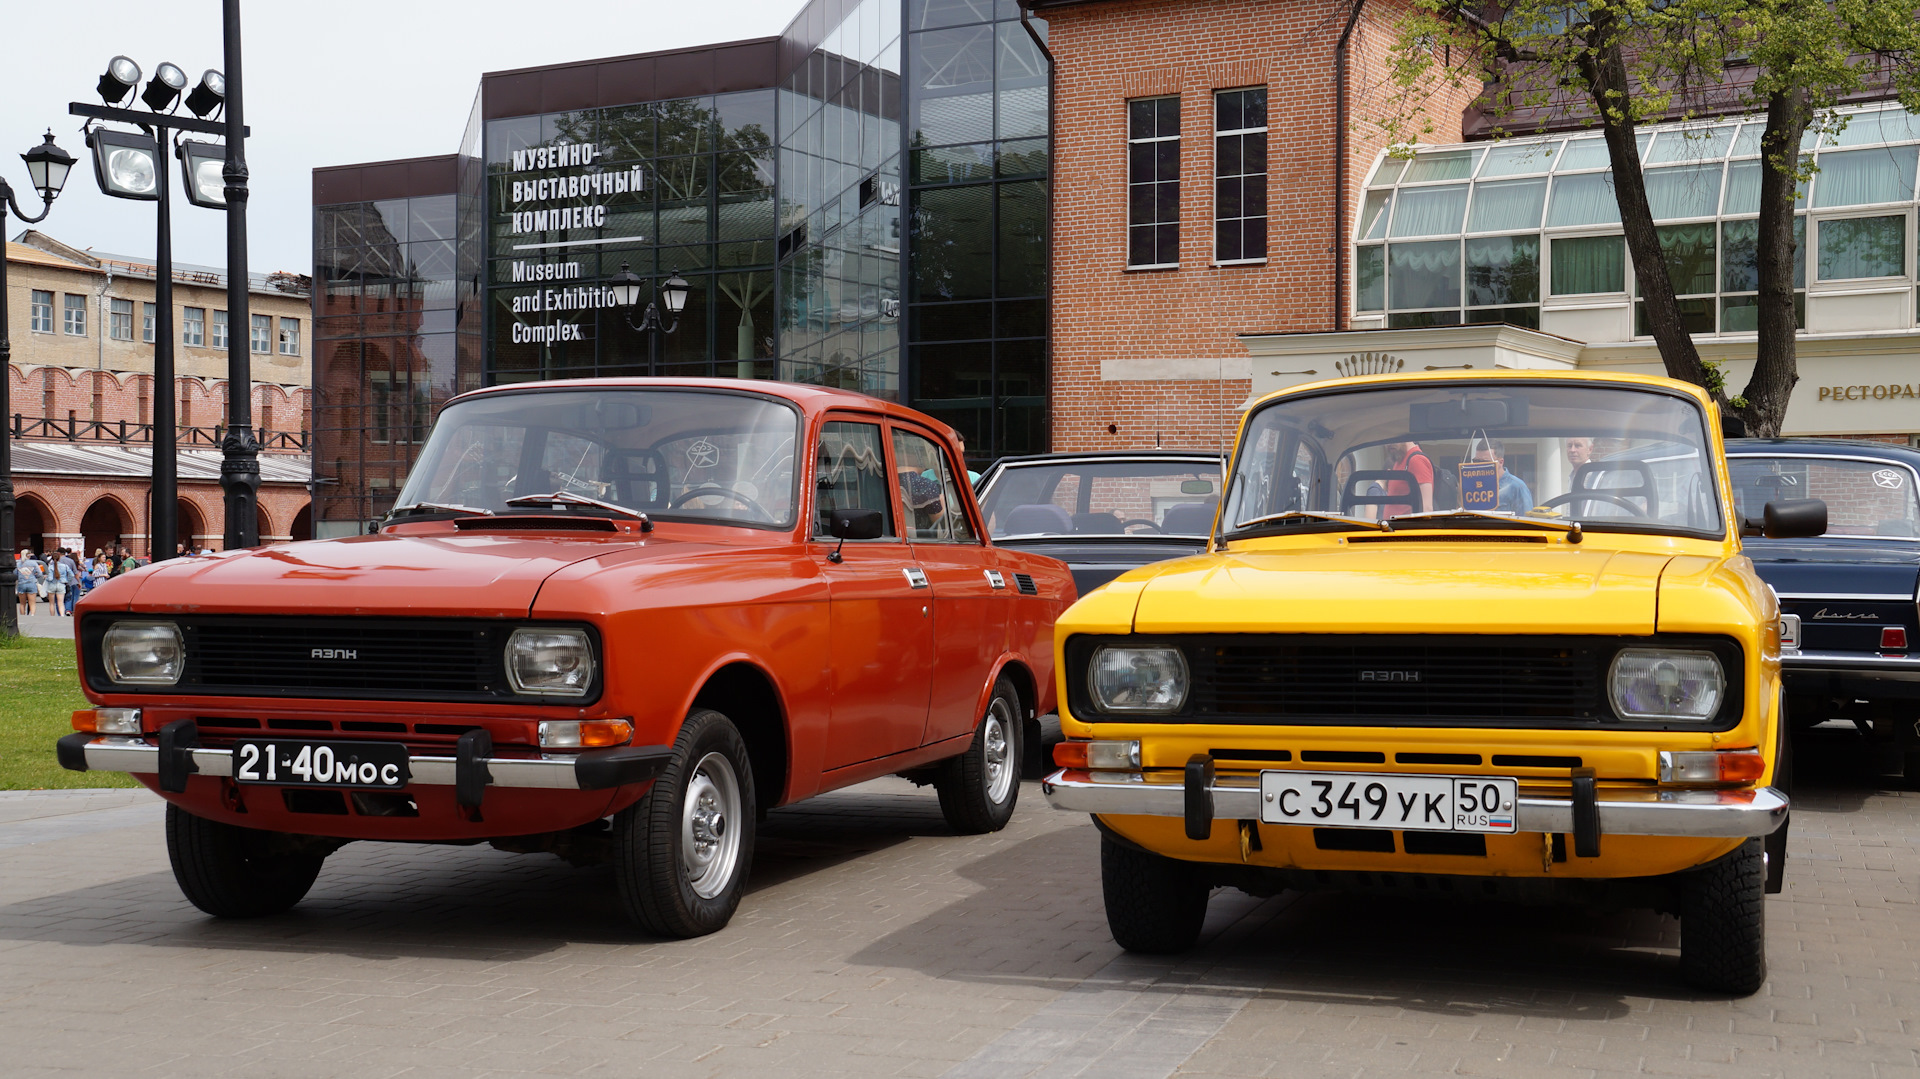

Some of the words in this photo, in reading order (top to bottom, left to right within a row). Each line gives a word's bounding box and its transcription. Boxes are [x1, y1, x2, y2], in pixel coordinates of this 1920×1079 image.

[513, 142, 602, 171] МУЗЕЙНО-
[513, 165, 643, 202] ВЫСТАВОЧНЫЙ
[513, 205, 605, 233] КОМПЛЕКС
[513, 261, 579, 282] Museum
[513, 289, 540, 313] and
[545, 286, 615, 311] Exhibitio
[513, 319, 581, 347] Complex
[1818, 384, 1920, 401] РЕСТОРА
[1466, 490, 1494, 503] СССР
[1459, 783, 1500, 813] 50
[1457, 814, 1488, 826] RUS
